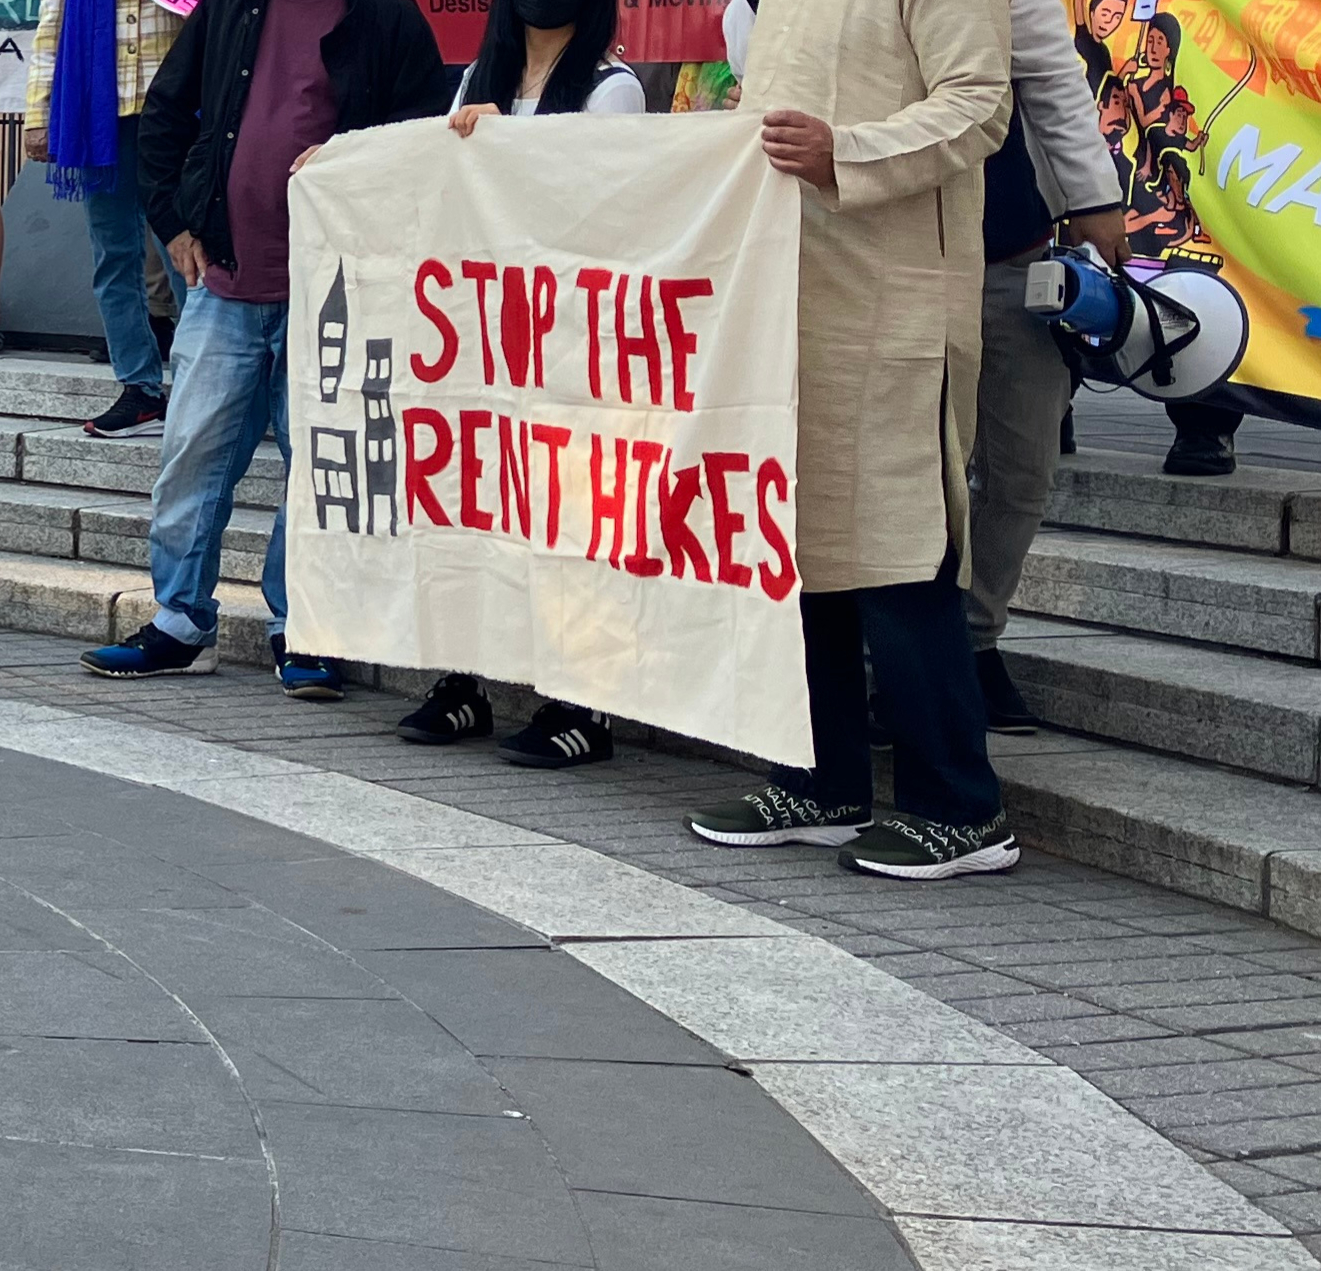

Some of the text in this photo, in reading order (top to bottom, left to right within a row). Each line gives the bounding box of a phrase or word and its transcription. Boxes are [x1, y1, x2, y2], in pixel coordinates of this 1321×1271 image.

[410, 258, 714, 412] STOP THE
[402, 407, 797, 602] RENT HIKES
